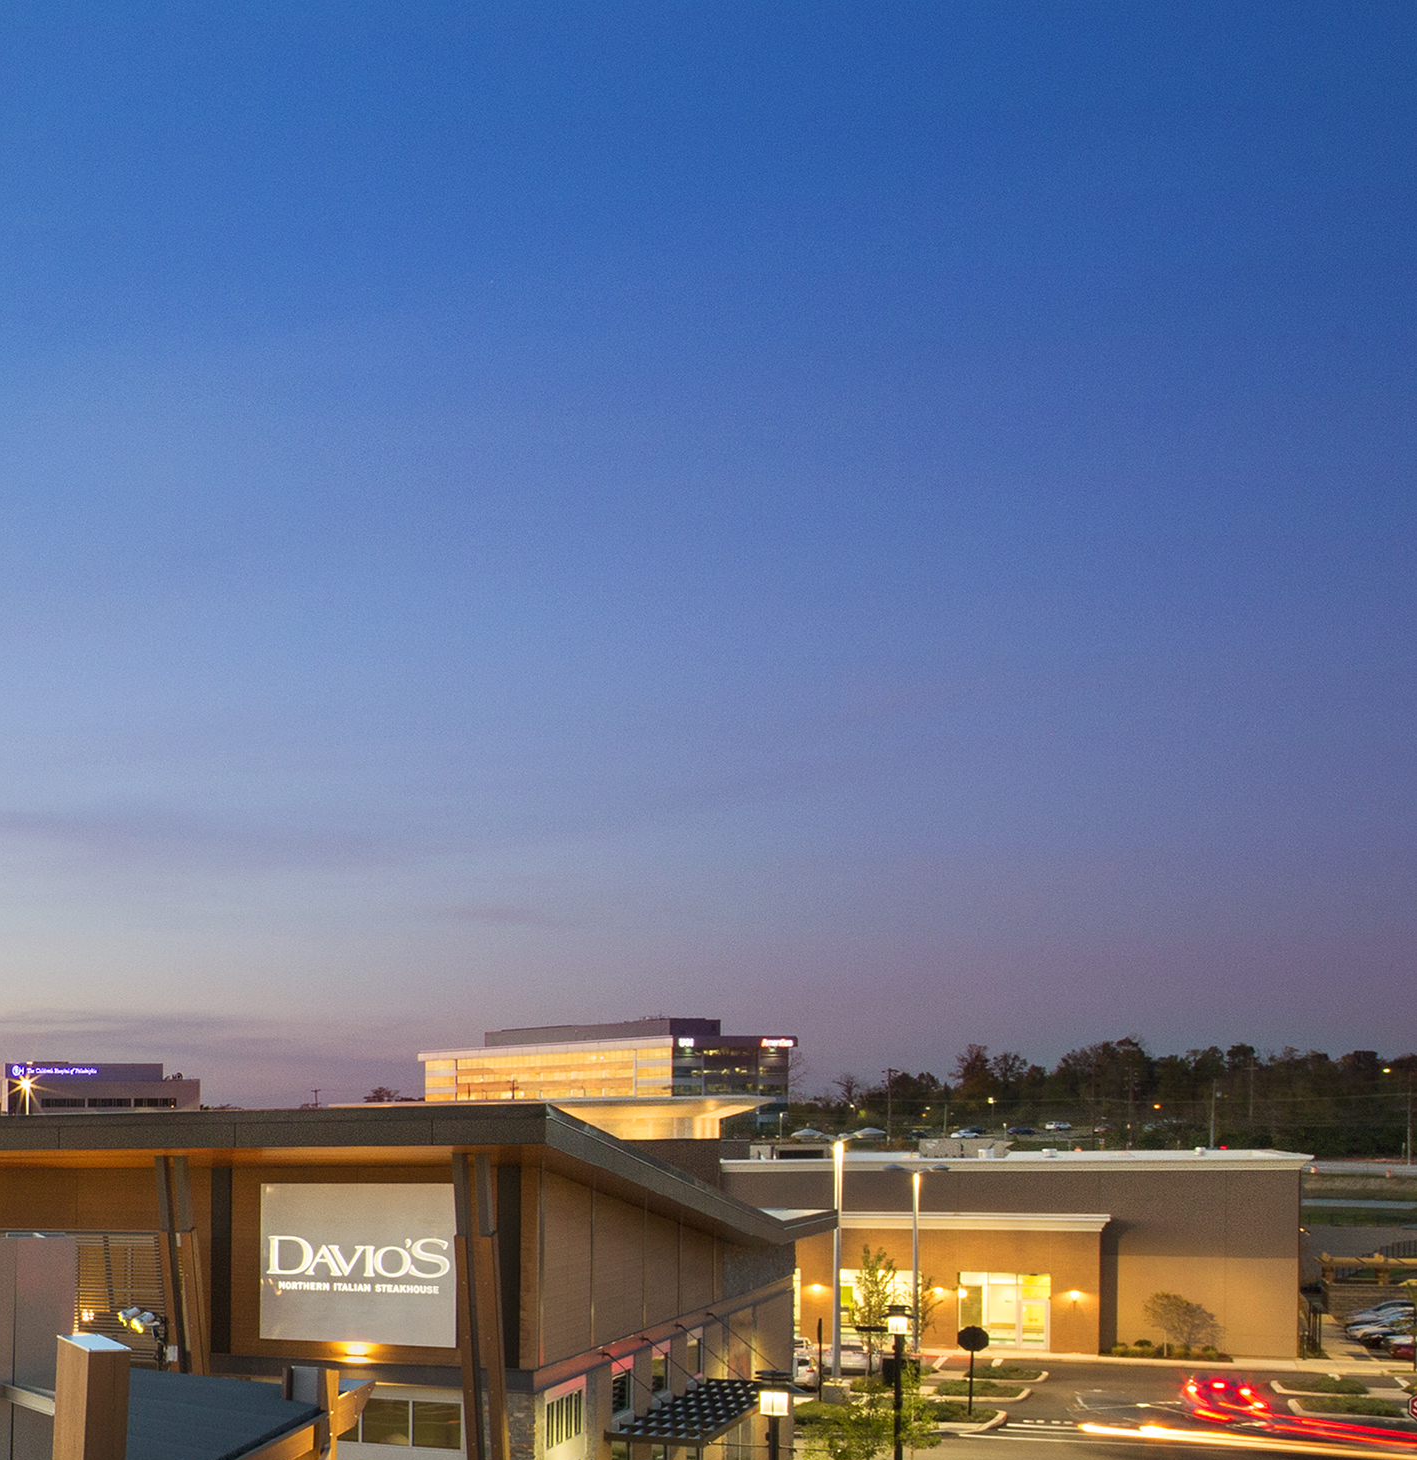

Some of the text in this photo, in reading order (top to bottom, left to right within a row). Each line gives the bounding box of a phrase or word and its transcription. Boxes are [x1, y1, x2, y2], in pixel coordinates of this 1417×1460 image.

[278, 1281, 439, 1294] NORTHERN ITALIAN STEAKHOUSE
